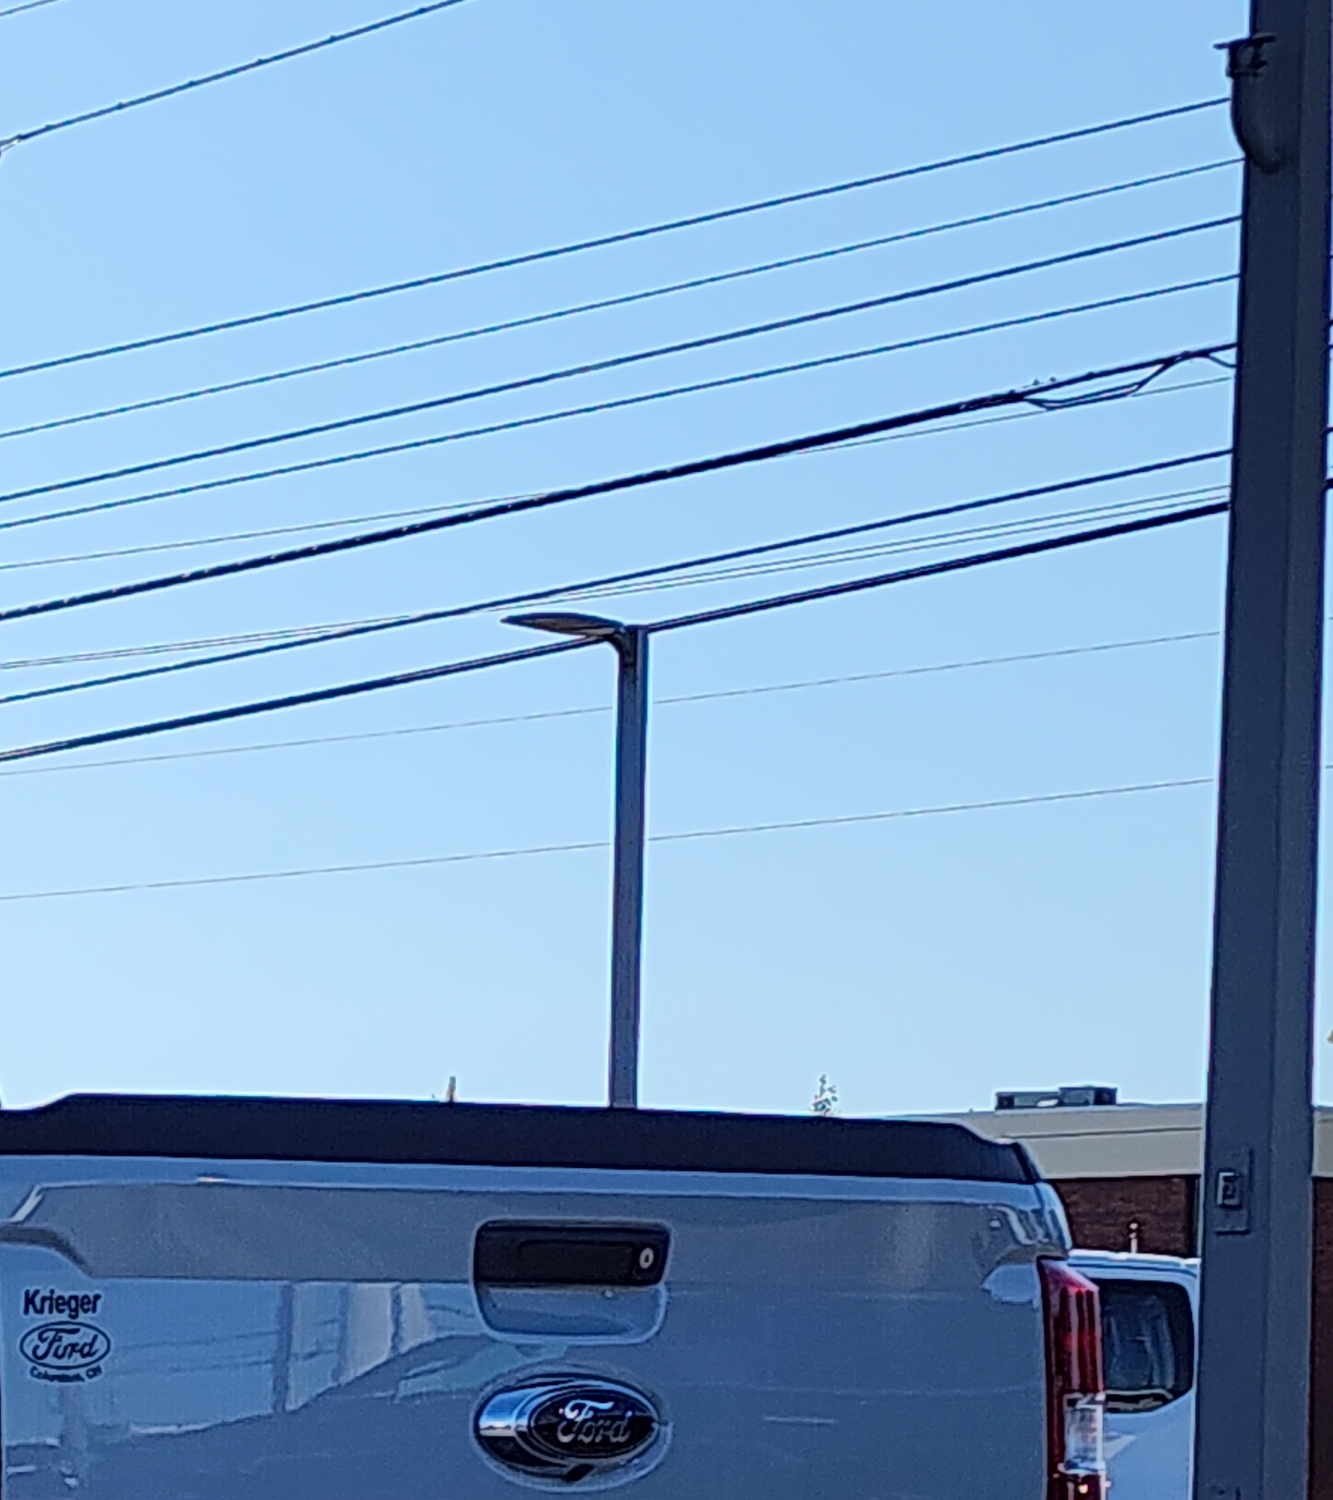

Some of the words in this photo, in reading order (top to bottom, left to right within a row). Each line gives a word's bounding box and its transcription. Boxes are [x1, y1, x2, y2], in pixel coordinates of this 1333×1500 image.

[23, 1288, 102, 1319] Krieger
[33, 1328, 99, 1360] Ford
[556, 1398, 633, 1444] Ford
